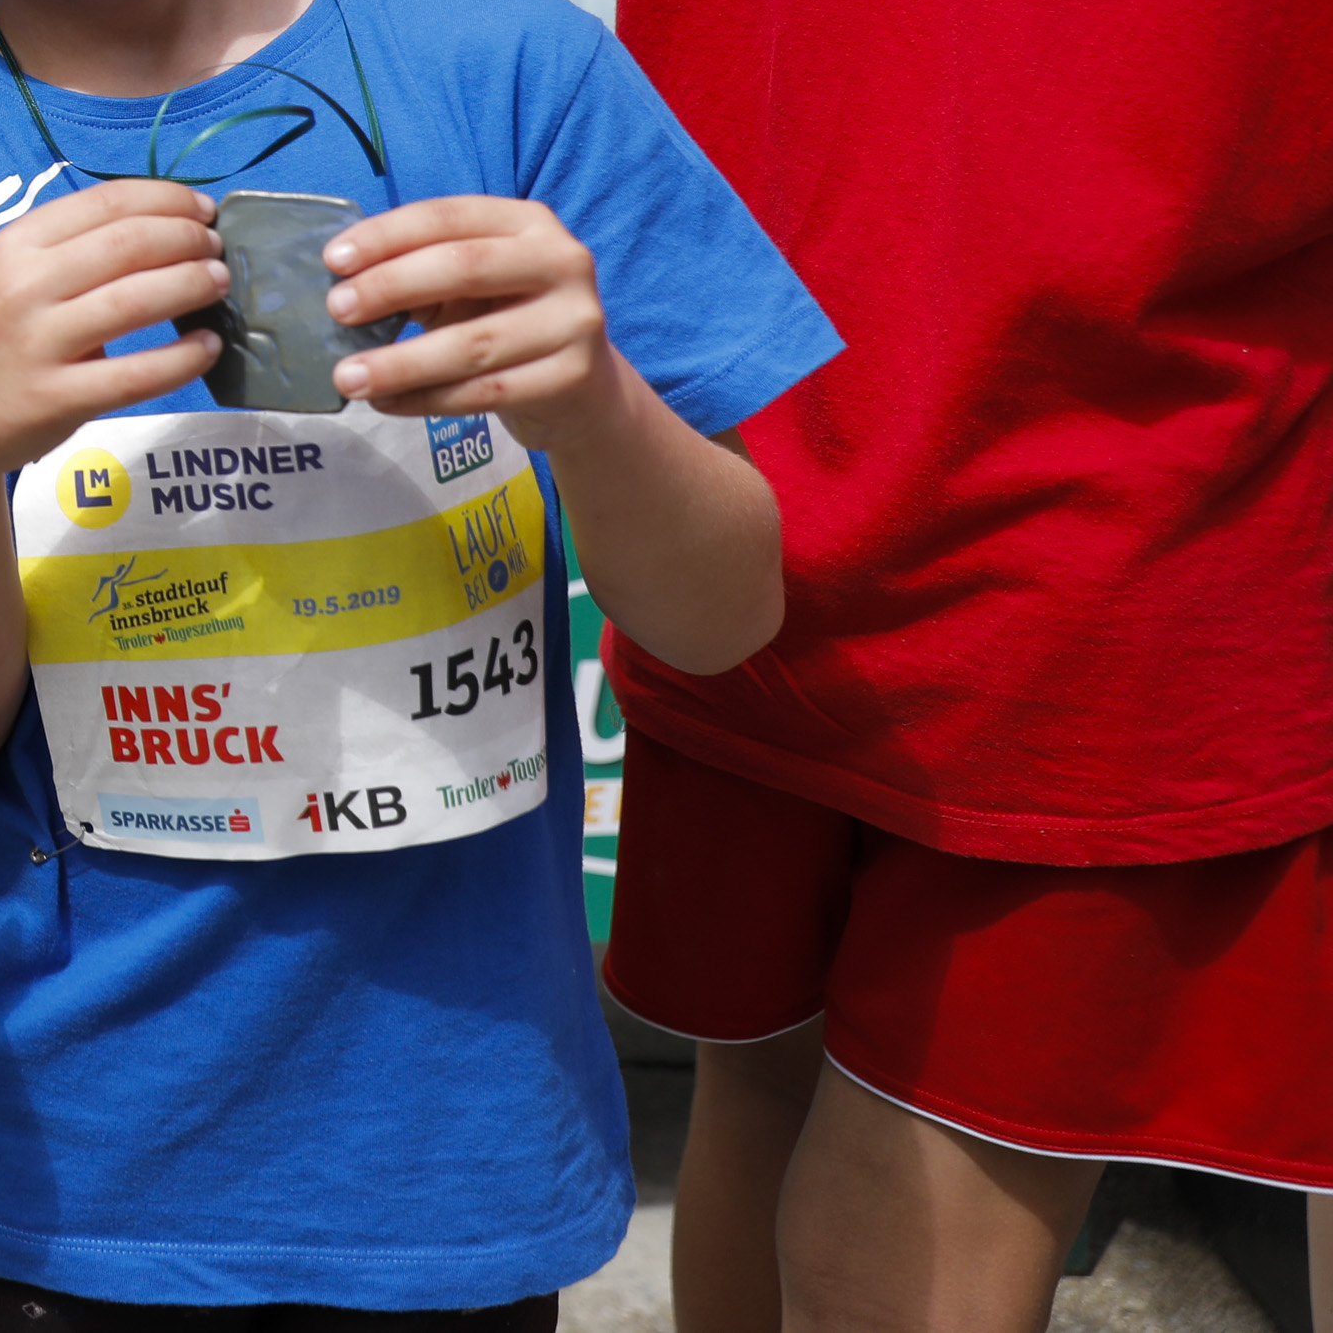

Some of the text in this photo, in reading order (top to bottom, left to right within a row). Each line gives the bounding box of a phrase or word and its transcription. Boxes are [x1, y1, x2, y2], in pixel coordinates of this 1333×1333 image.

[433, 422, 459, 443] vom
[146, 443, 322, 479] LINDNER
[436, 431, 490, 478] BERG
[152, 481, 273, 515] MUSIC
[448, 485, 517, 576] LÄUFT
[135, 571, 228, 607] stadtlauf
[292, 585, 400, 618] 19.5.2019
[464, 573, 488, 611] BEI
[109, 598, 210, 631] innsbruck
[114, 616, 245, 651] Tiroler Tageszeitung
[410, 619, 538, 721] 1543
[107, 726, 284, 766] BRUCK
[437, 745, 546, 809] Tiroler Tages
[110, 810, 229, 833] SPARKASSE
